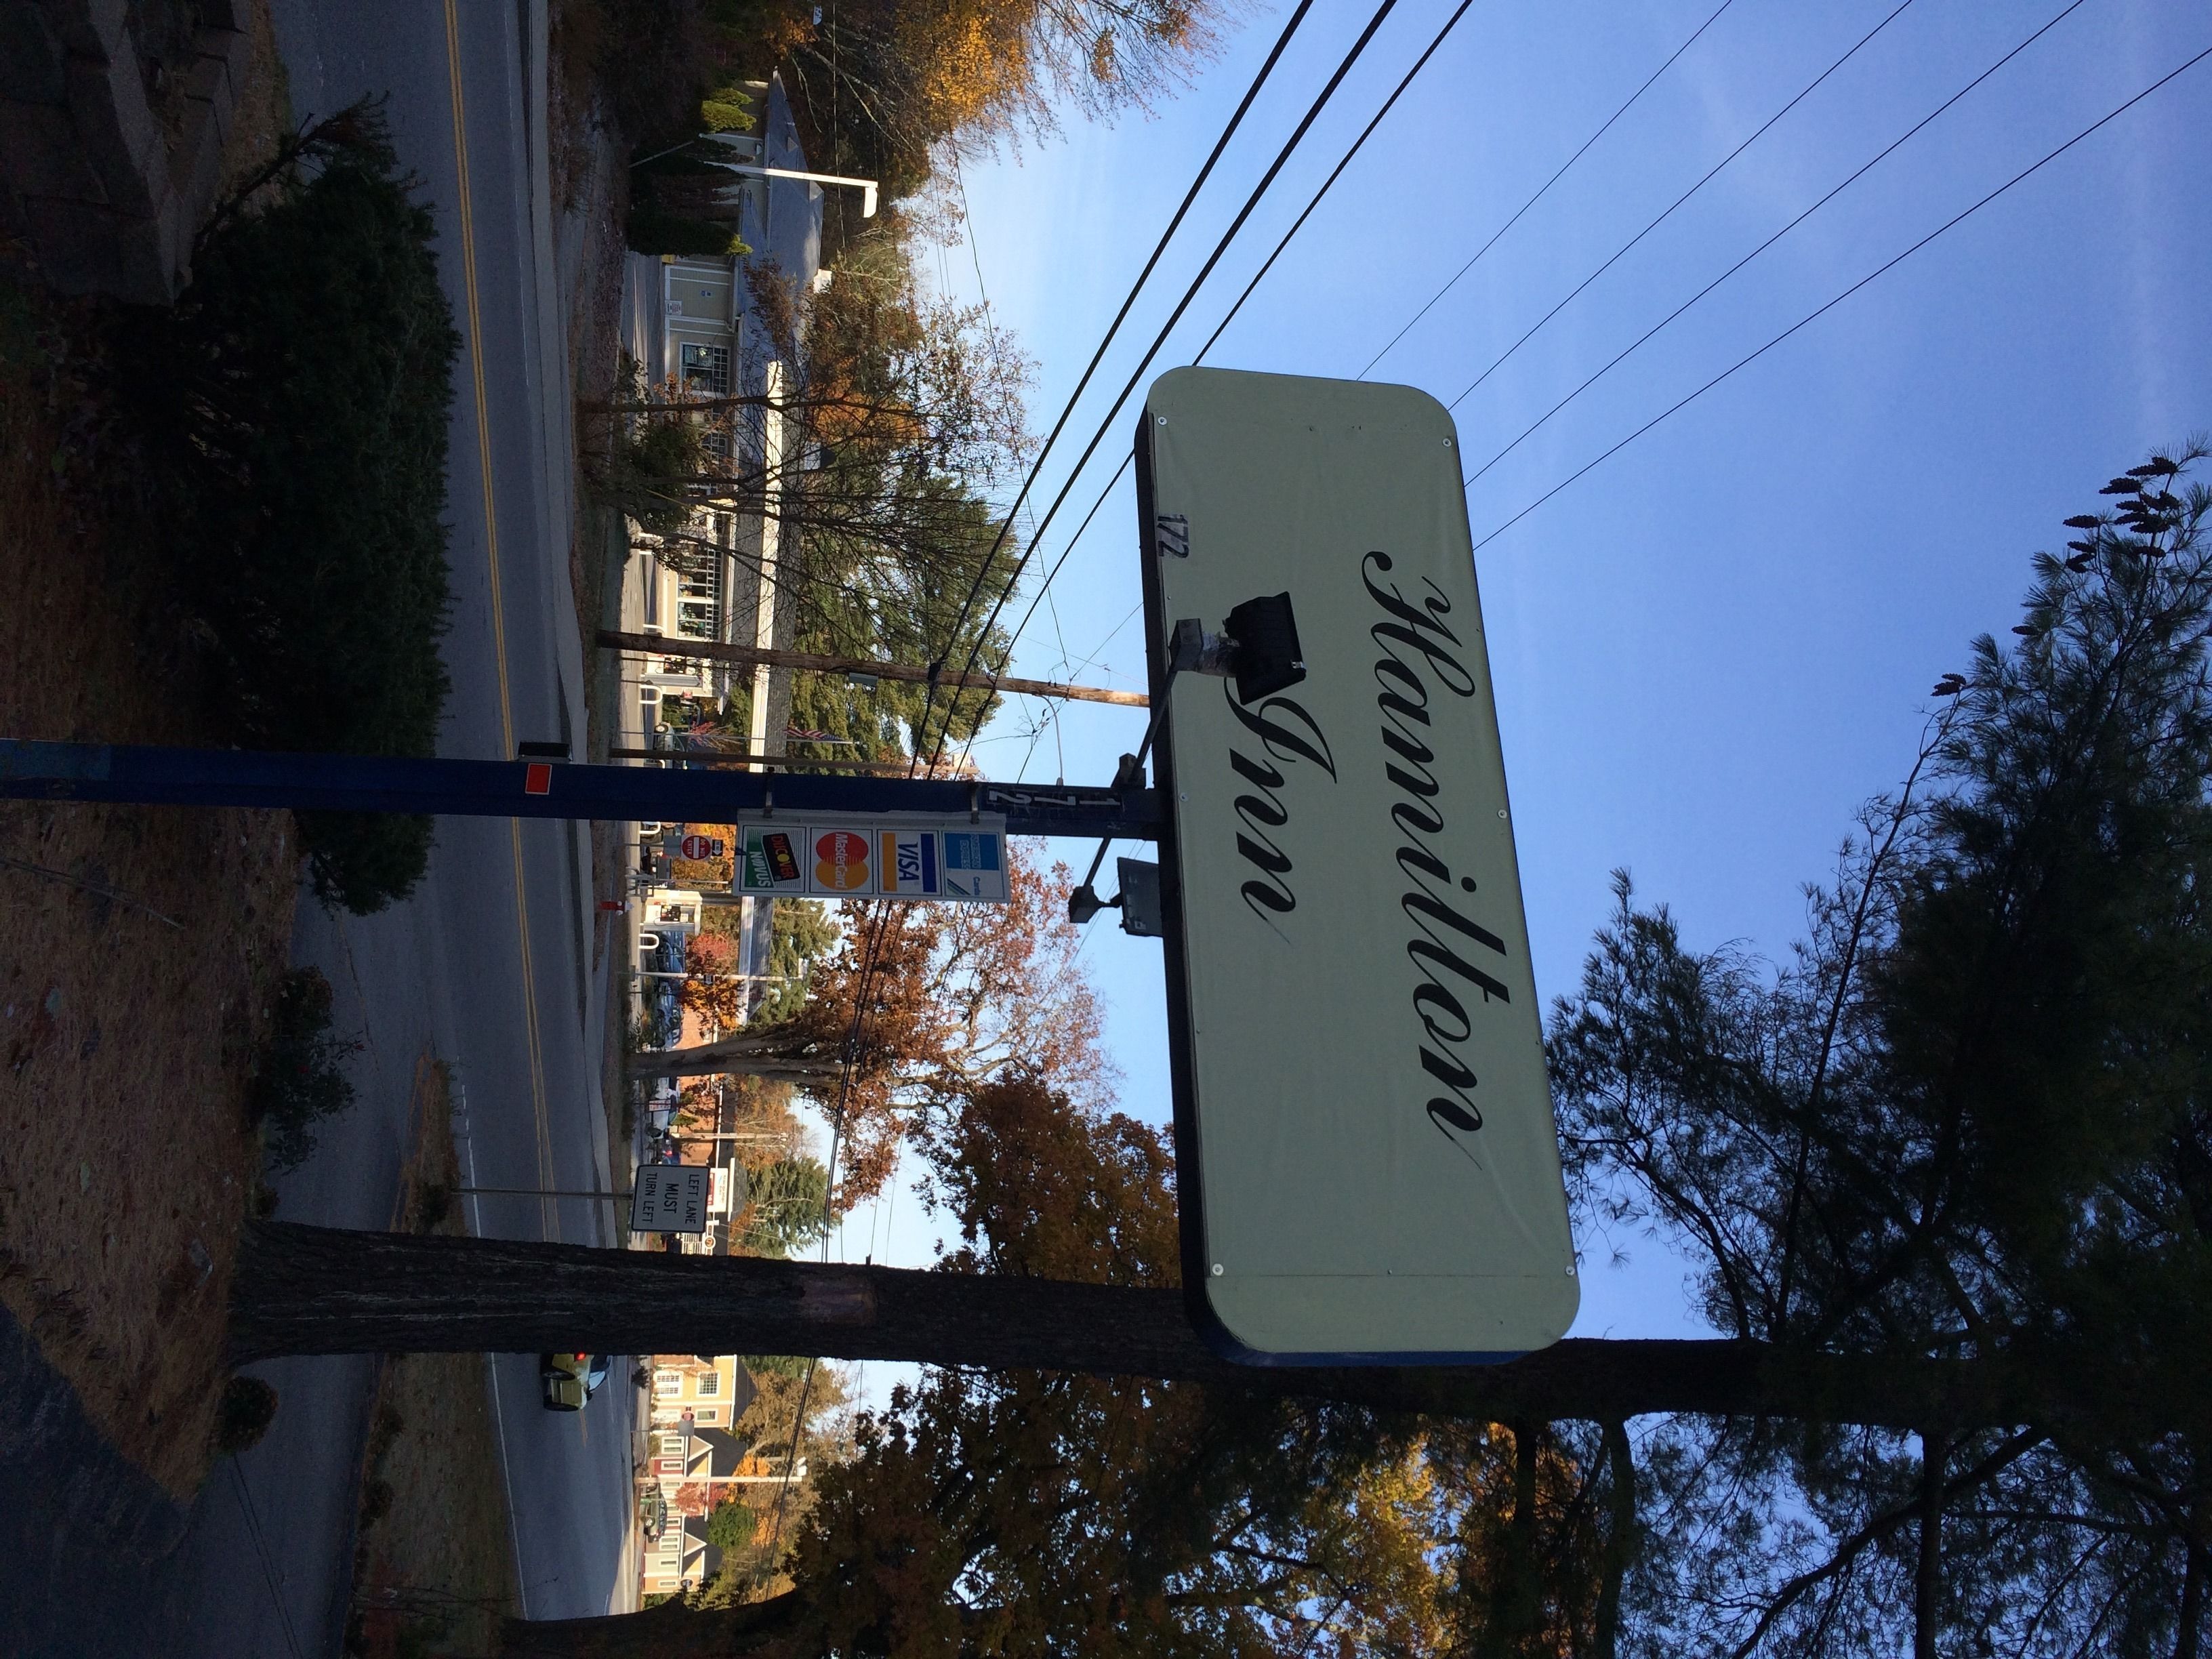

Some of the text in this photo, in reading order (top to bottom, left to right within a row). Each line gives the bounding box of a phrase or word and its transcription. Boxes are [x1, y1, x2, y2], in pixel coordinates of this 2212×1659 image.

[1158, 514, 1189, 559] 172
[988, 790, 1120, 806] 172
[1223, 678, 1337, 945] Inn
[749, 851, 771, 886] NOVUS
[771, 836, 794, 879] DISCOVER
[835, 833, 848, 888] MasterCard
[898, 842, 920, 881] VISA
[960, 840, 970, 869] EXPRESS
[970, 834, 981, 869] AMERICAN
[1361, 550, 1511, 1170] Hamilton
[641, 1172, 657, 1223] TURN LEFT
[663, 1183, 679, 1214] MUST
[684, 1174, 700, 1225] LEFT LANE
